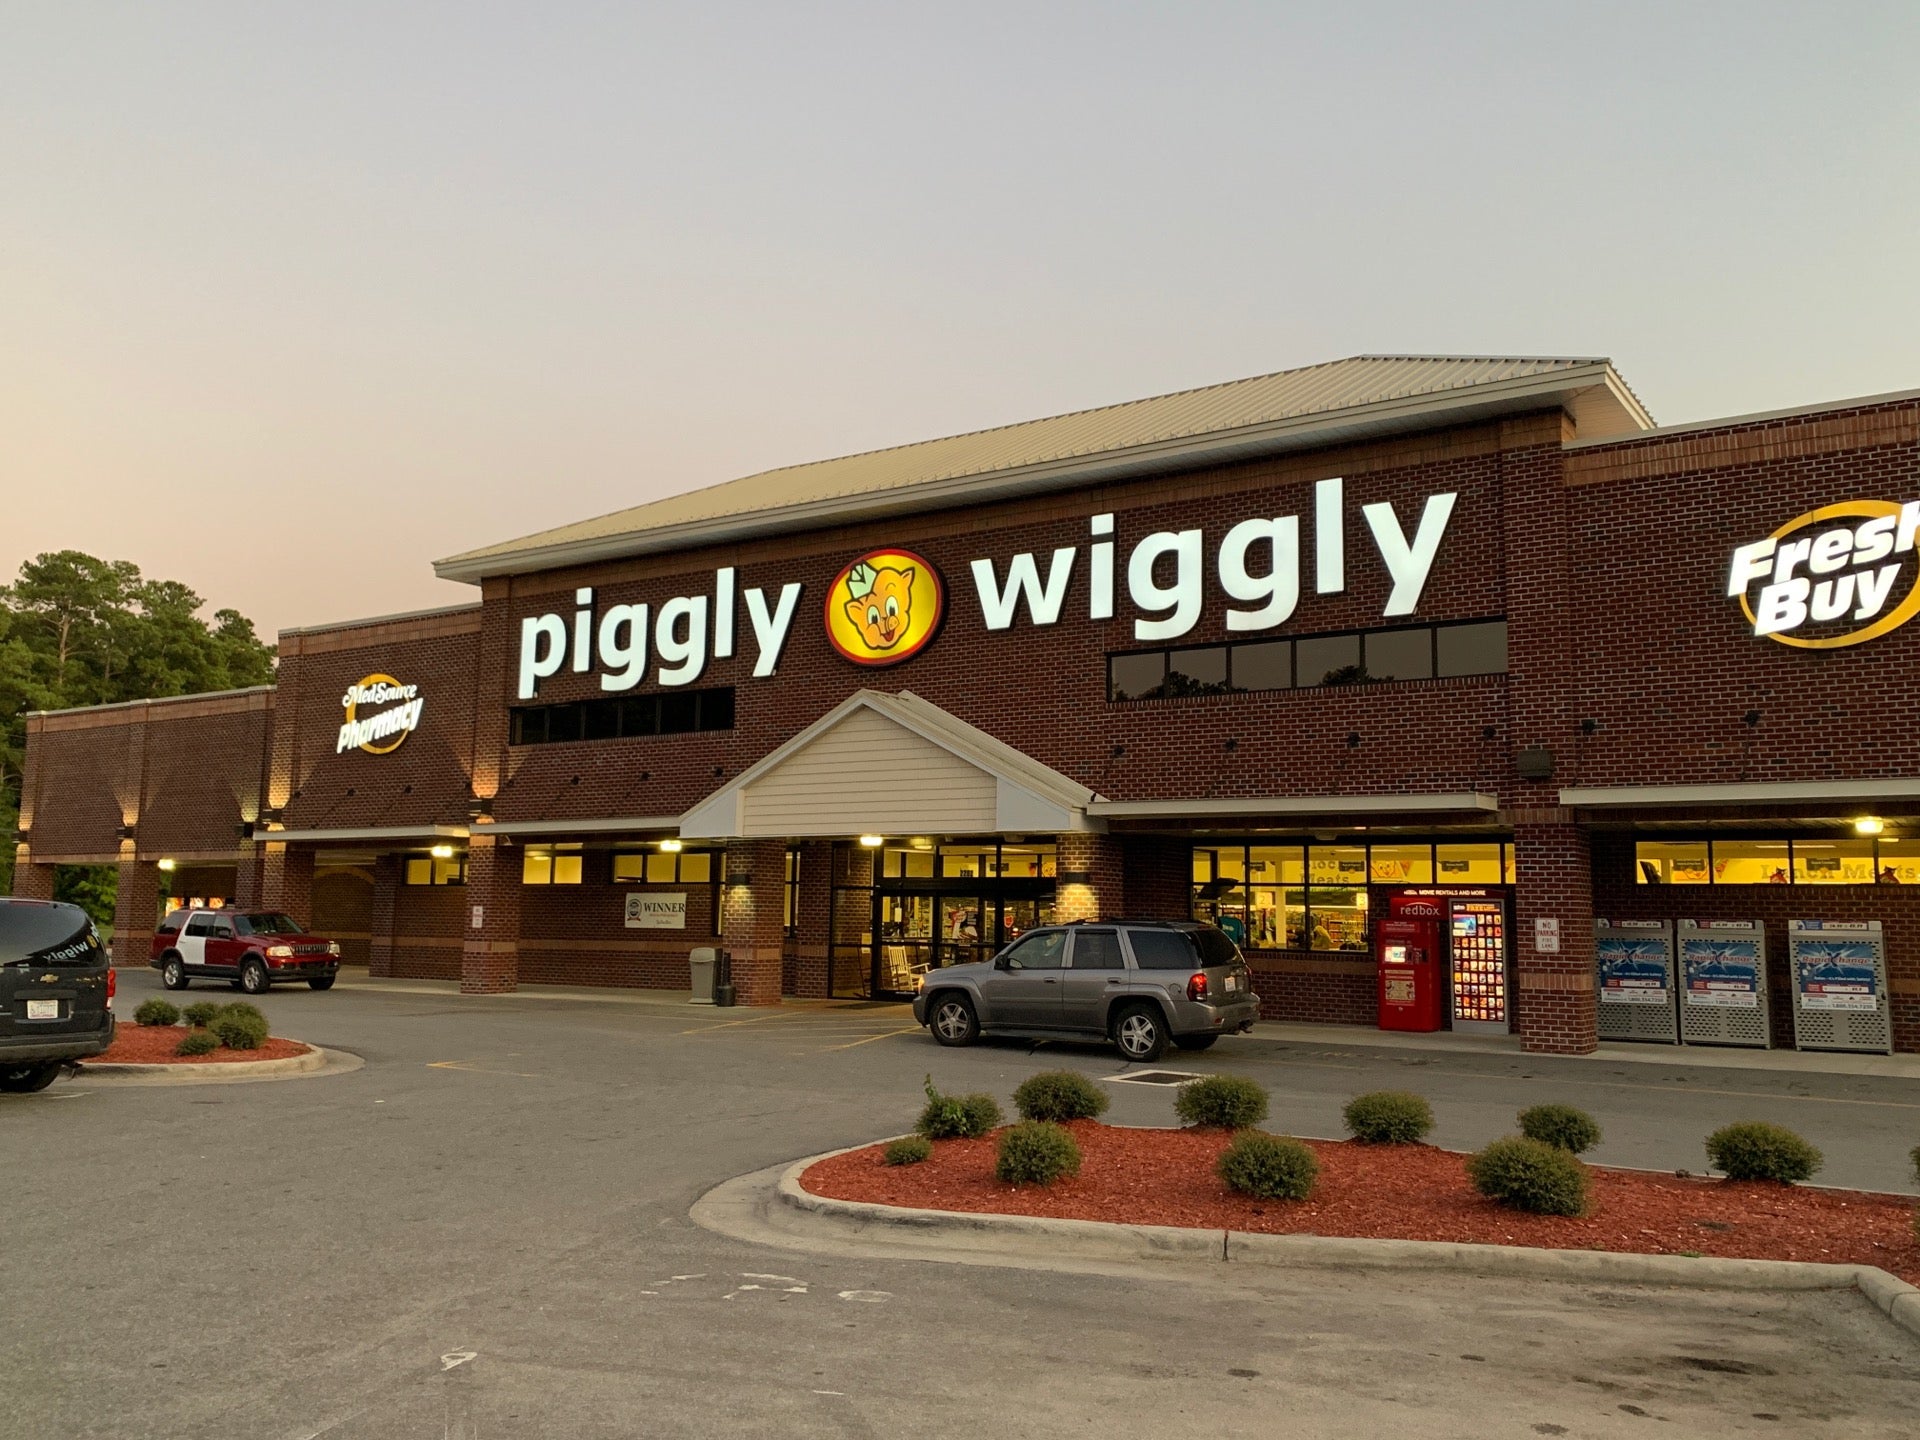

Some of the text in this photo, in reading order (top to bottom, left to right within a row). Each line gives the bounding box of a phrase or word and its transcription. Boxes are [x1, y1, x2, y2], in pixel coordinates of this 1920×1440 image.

[518, 477, 1458, 700] piggly wiggly
[1754, 562, 1902, 636] Buy
[342, 682, 417, 708] MedSource
[336, 697, 424, 754] Pharmacy
[643, 902, 685, 912] WINNER
[1400, 905, 1440, 916] redbox
[1542, 921, 1552, 929] NO
